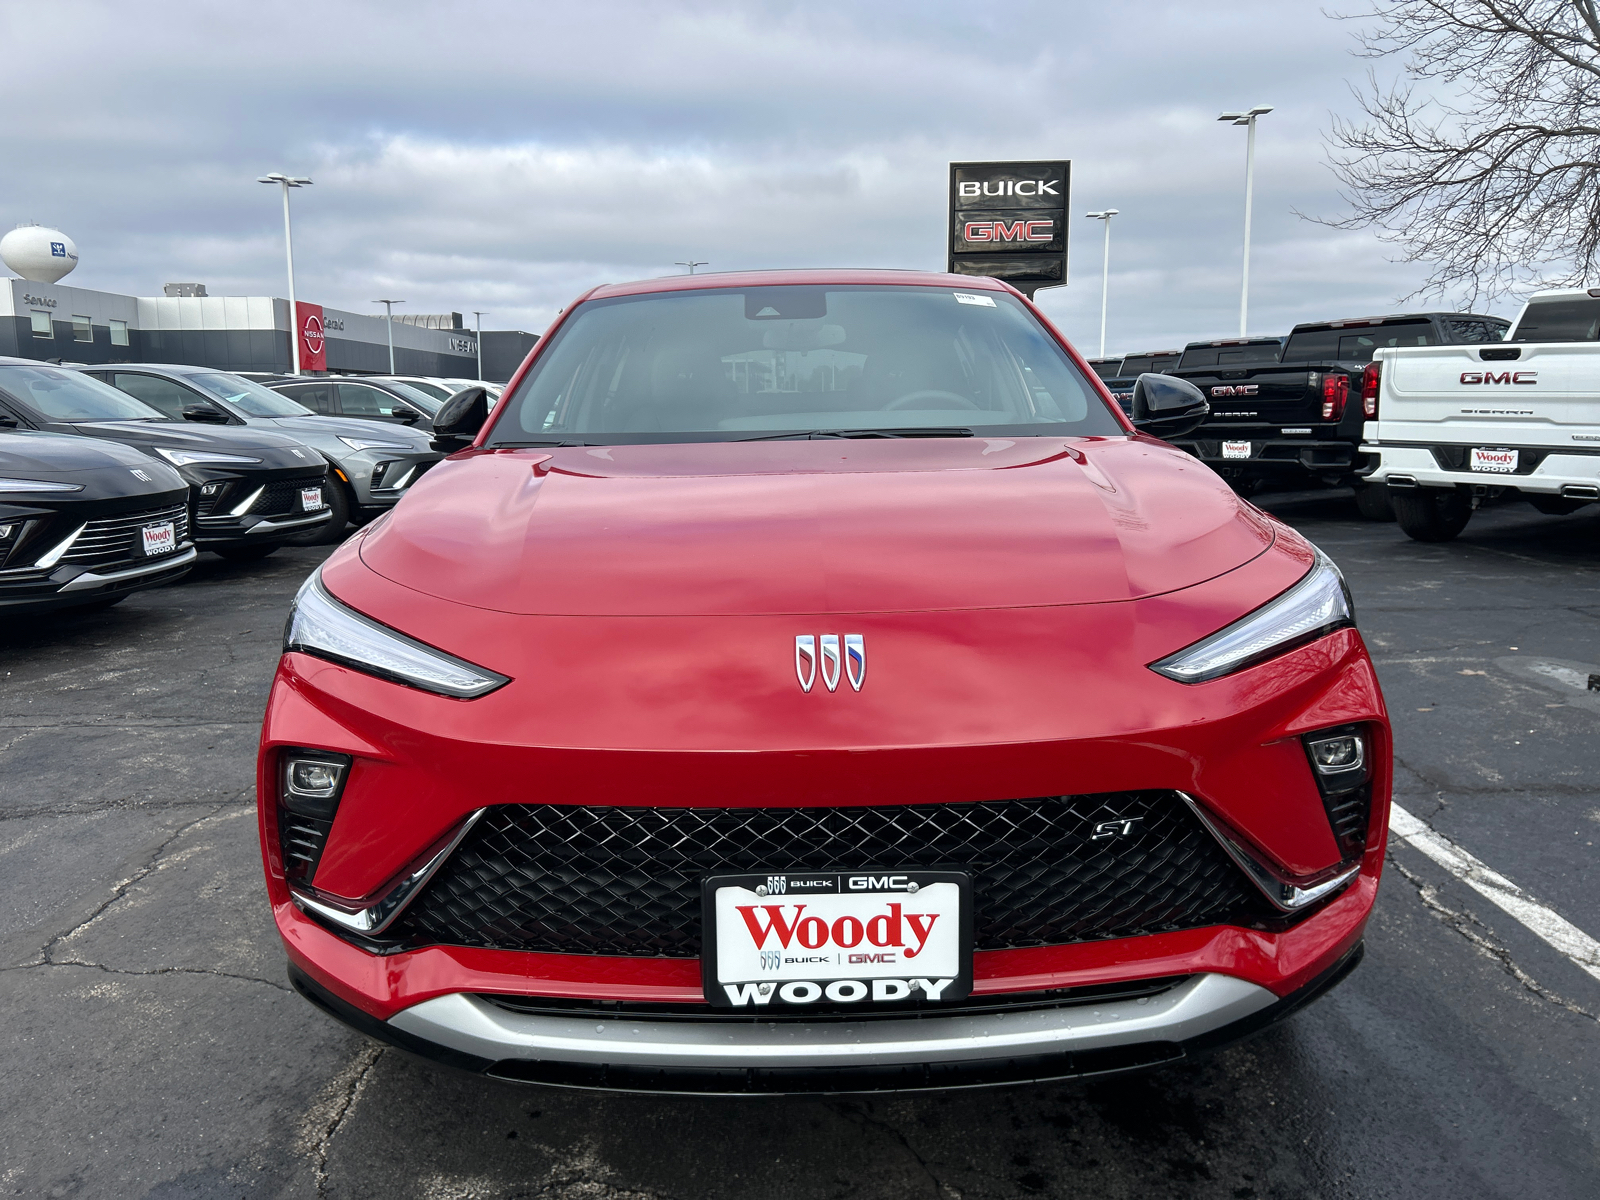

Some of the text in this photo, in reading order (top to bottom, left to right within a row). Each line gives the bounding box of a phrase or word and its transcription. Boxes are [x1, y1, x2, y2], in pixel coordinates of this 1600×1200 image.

[958, 180, 1060, 197] BUICK
[964, 220, 1054, 242] GMC
[23, 293, 57, 308] Service
[323, 316, 344, 331] Gerald
[304, 330, 324, 338] NISSAN
[1459, 371, 1538, 385] GMC
[1111, 392, 1134, 400] MC
[1211, 384, 1259, 397] GMC
[1225, 444, 1248, 453] Woody
[1475, 451, 1515, 465] Woody
[1471, 465, 1516, 473] WOODY
[303, 492, 320, 503] Woody
[145, 528, 172, 542] Woody
[145, 544, 176, 557] WOODY
[1091, 816, 1144, 840] ST
[790, 876, 909, 890] BUICK GMC
[735, 902, 941, 959] Woody
[784, 952, 896, 964] BUICK GMC
[723, 979, 954, 1006] WOODY
